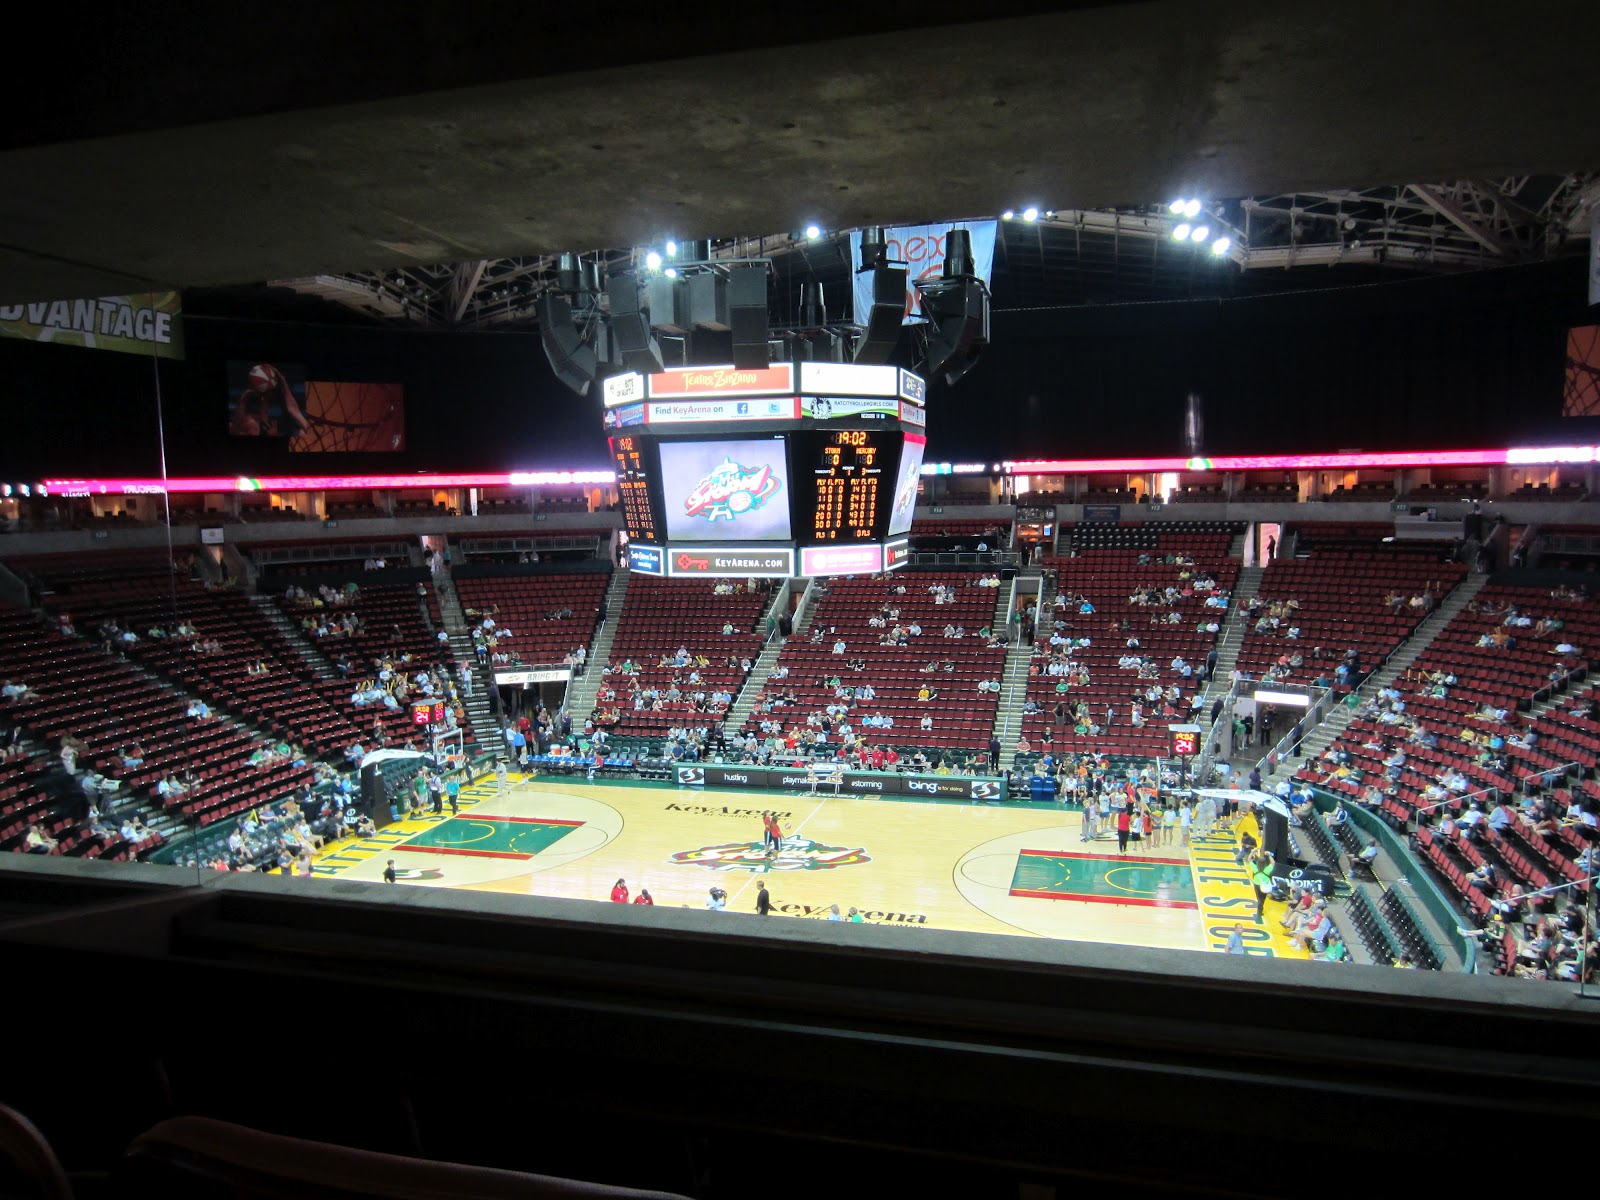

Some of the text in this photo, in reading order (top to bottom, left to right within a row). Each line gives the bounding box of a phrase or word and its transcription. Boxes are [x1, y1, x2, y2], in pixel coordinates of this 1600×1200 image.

[655, 406, 672, 415] Find
[673, 405, 711, 415] KeyArena
[838, 431, 866, 445] 19:02
[834, 478, 845, 486] PTS
[715, 557, 783, 568] KEYARENA.COM
[527, 672, 550, 681] BRING
[416, 712, 429, 723] 24
[1175, 732, 1195, 741] 19:02
[1175, 739, 1192, 752] 24
[724, 773, 748, 783] hustling
[908, 780, 938, 793] bing
[665, 803, 792, 817] KeyArena
